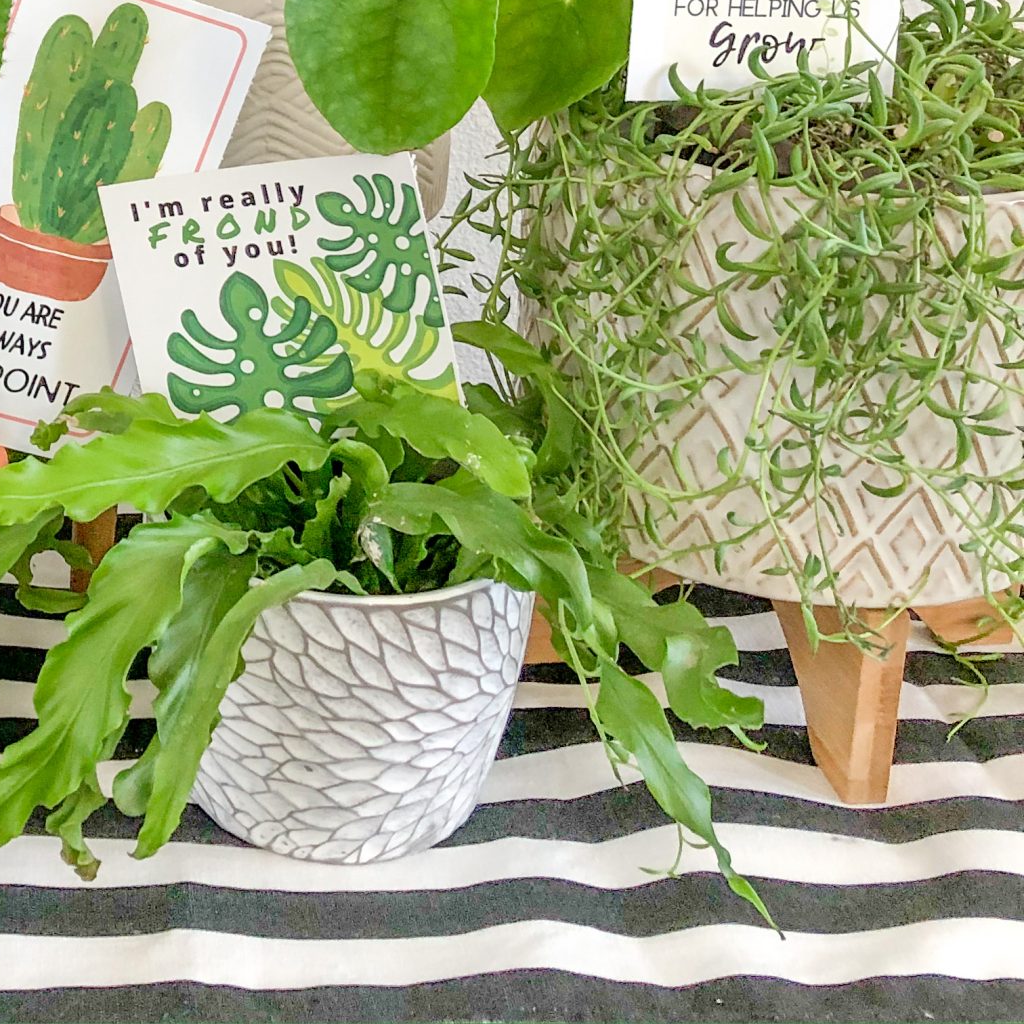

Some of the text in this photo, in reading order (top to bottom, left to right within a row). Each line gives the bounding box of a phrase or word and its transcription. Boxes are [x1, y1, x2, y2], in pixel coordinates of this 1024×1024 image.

[130, 182, 304, 222] I'm really
[148, 206, 311, 249] FROND
[173, 234, 299, 268] of you!
[19, 301, 65, 329] ARE
